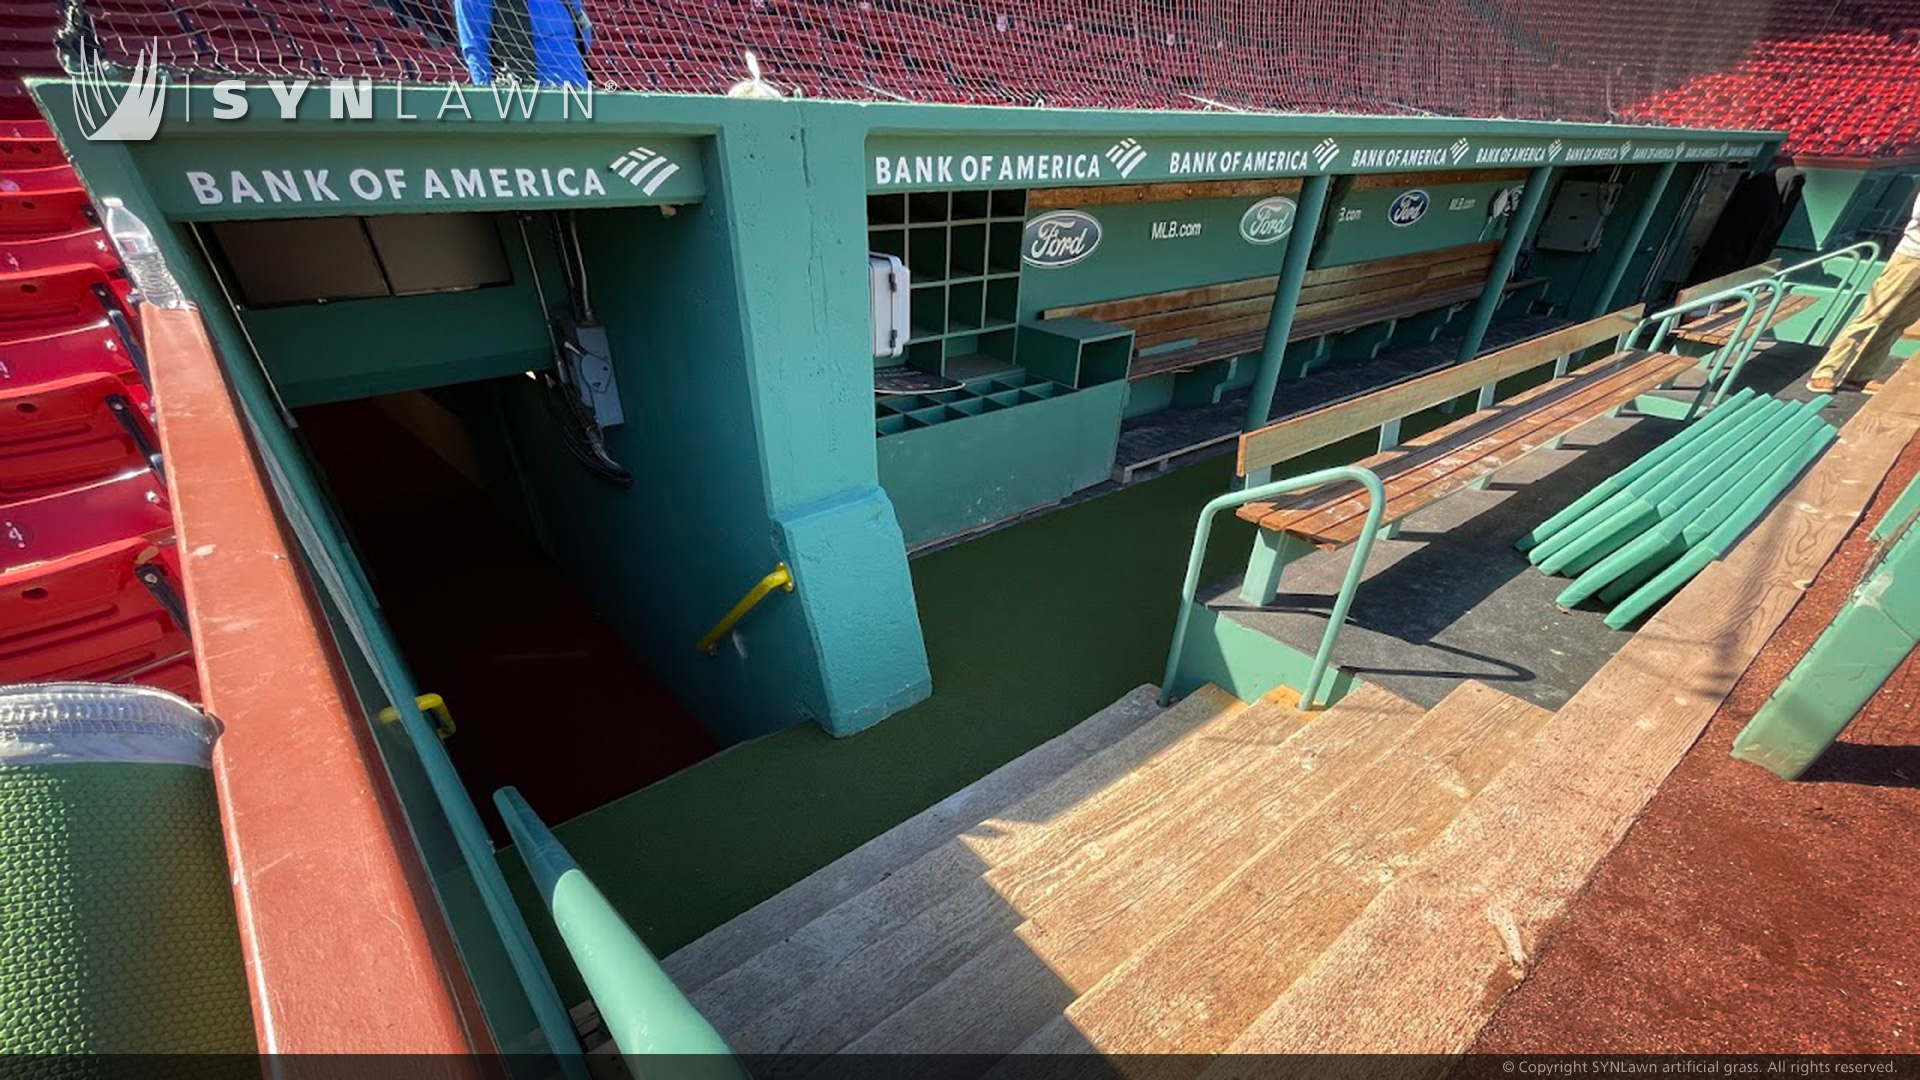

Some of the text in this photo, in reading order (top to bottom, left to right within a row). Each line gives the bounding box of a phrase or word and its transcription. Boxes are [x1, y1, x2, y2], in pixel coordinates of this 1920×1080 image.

[875, 153, 1101, 185] BANK OF AMERICA
[1169, 150, 1308, 174] BANK OF AMERICA
[1351, 148, 1448, 168] BANK OF AMERICA
[1475, 147, 1501, 164] BANK
[186, 167, 607, 205] BANK OF AMERICA
[1249, 205, 1288, 236] Ford
[1393, 194, 1425, 222] Ford
[1031, 220, 1088, 259] Ford
[1150, 221, 1203, 240] MLB.com
